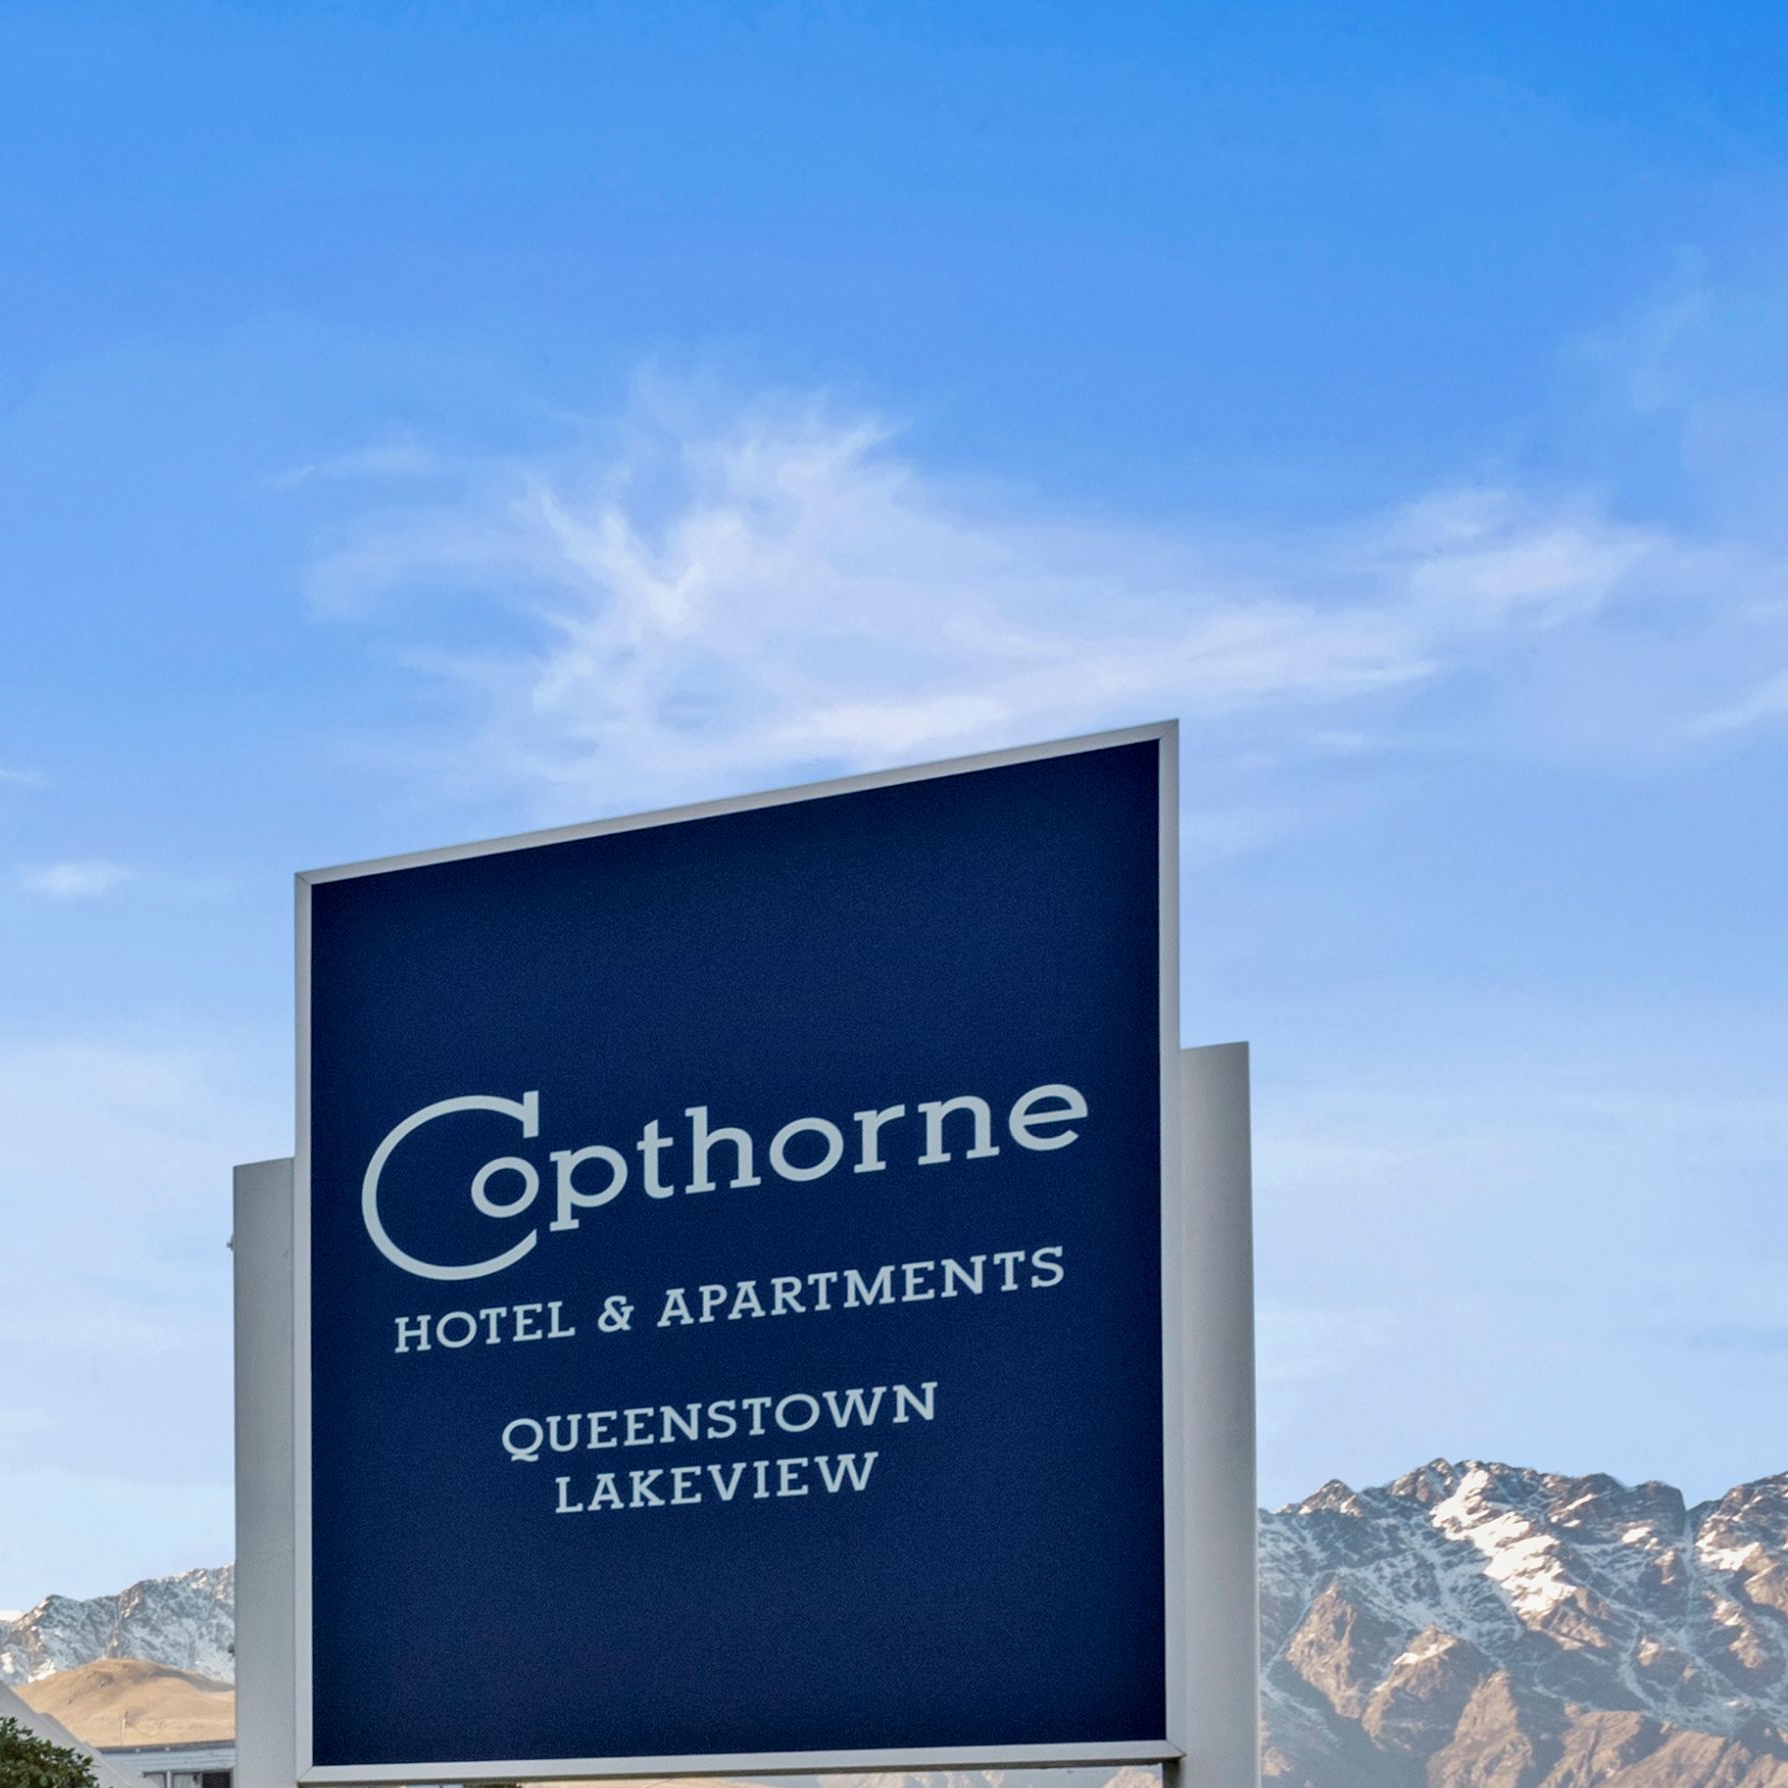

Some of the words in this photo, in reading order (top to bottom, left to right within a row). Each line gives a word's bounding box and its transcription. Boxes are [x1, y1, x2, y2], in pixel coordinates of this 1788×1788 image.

[361, 1084, 1088, 1281] Copthorne
[395, 1301, 576, 1353] HOTEL
[597, 1295, 634, 1333] &
[657, 1246, 1065, 1327] APARTMENTS
[502, 1381, 938, 1462] QUEENSTOWN
[555, 1451, 879, 1514] LAKEVIEW
